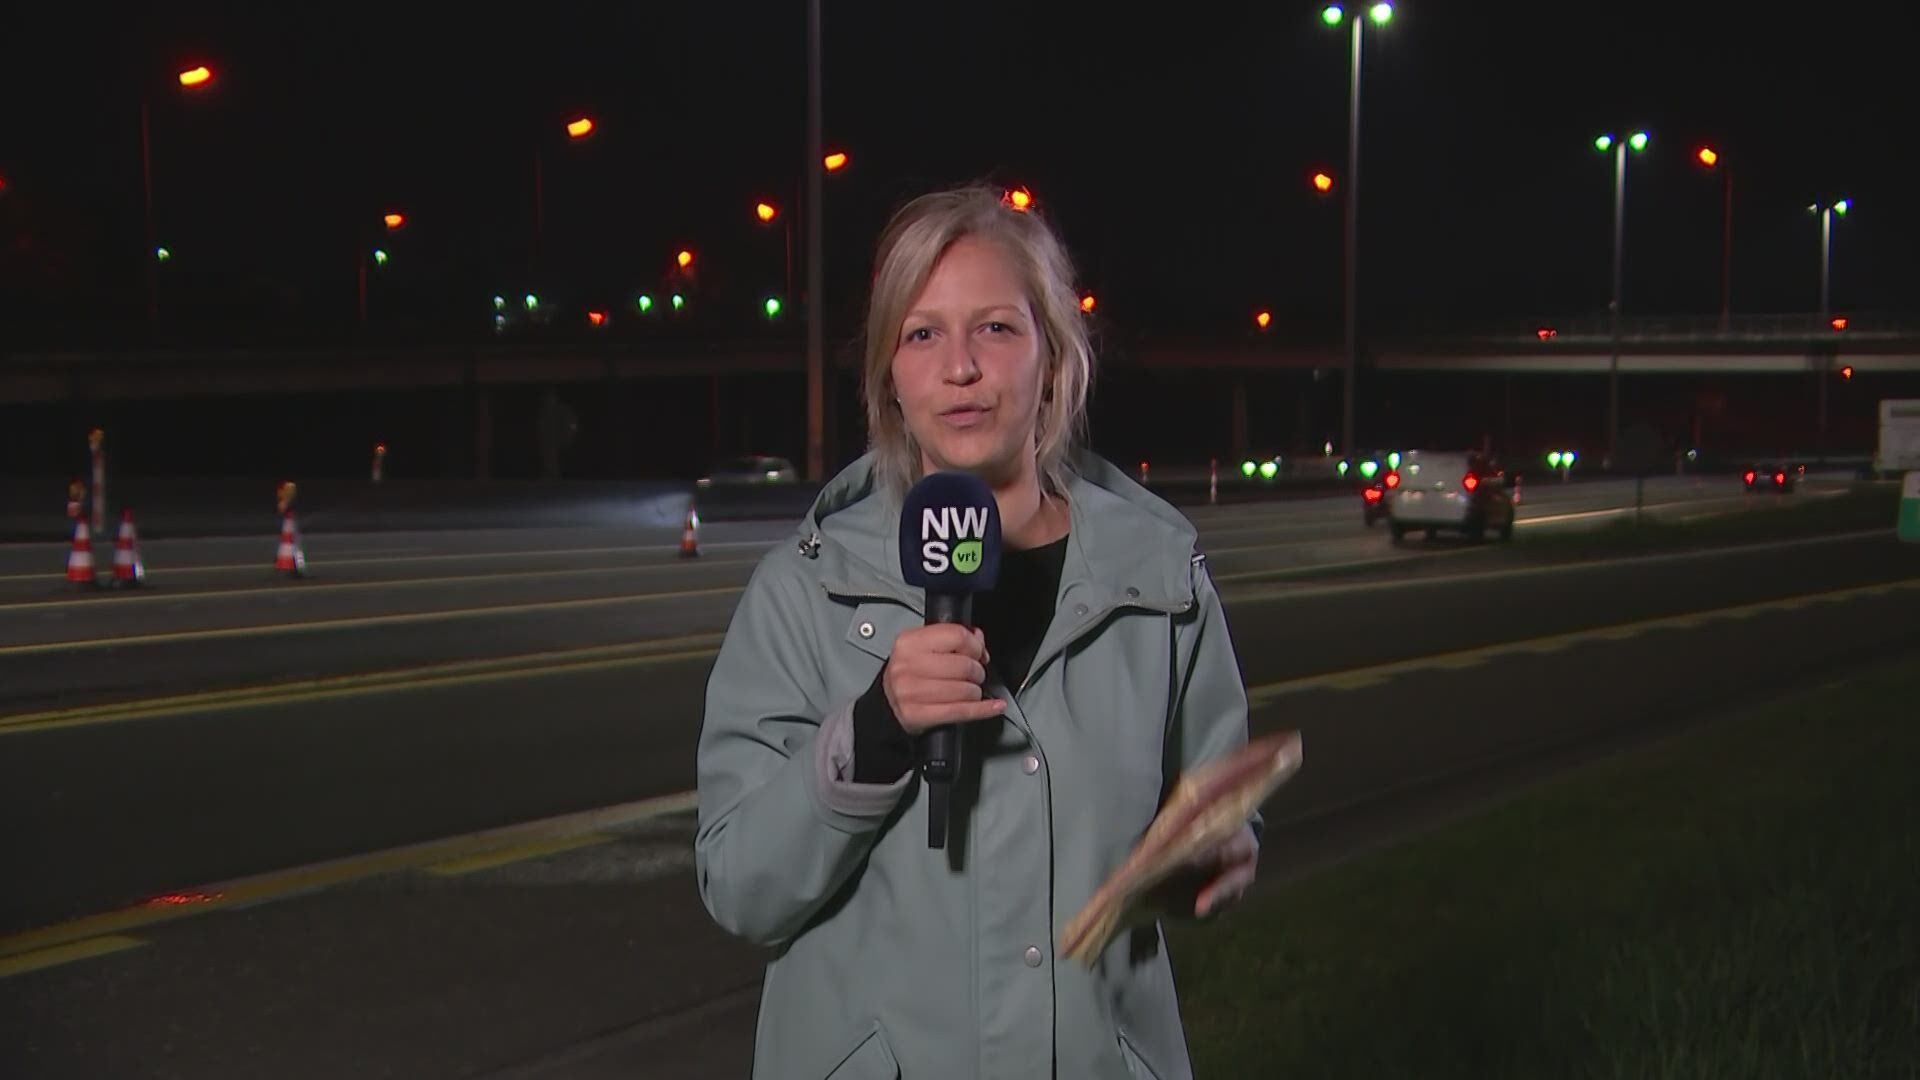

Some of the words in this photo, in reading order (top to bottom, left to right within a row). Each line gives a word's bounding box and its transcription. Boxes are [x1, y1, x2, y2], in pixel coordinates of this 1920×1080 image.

[921, 507, 988, 540] NW
[922, 541, 949, 574] S
[957, 551, 977, 563] vrt
